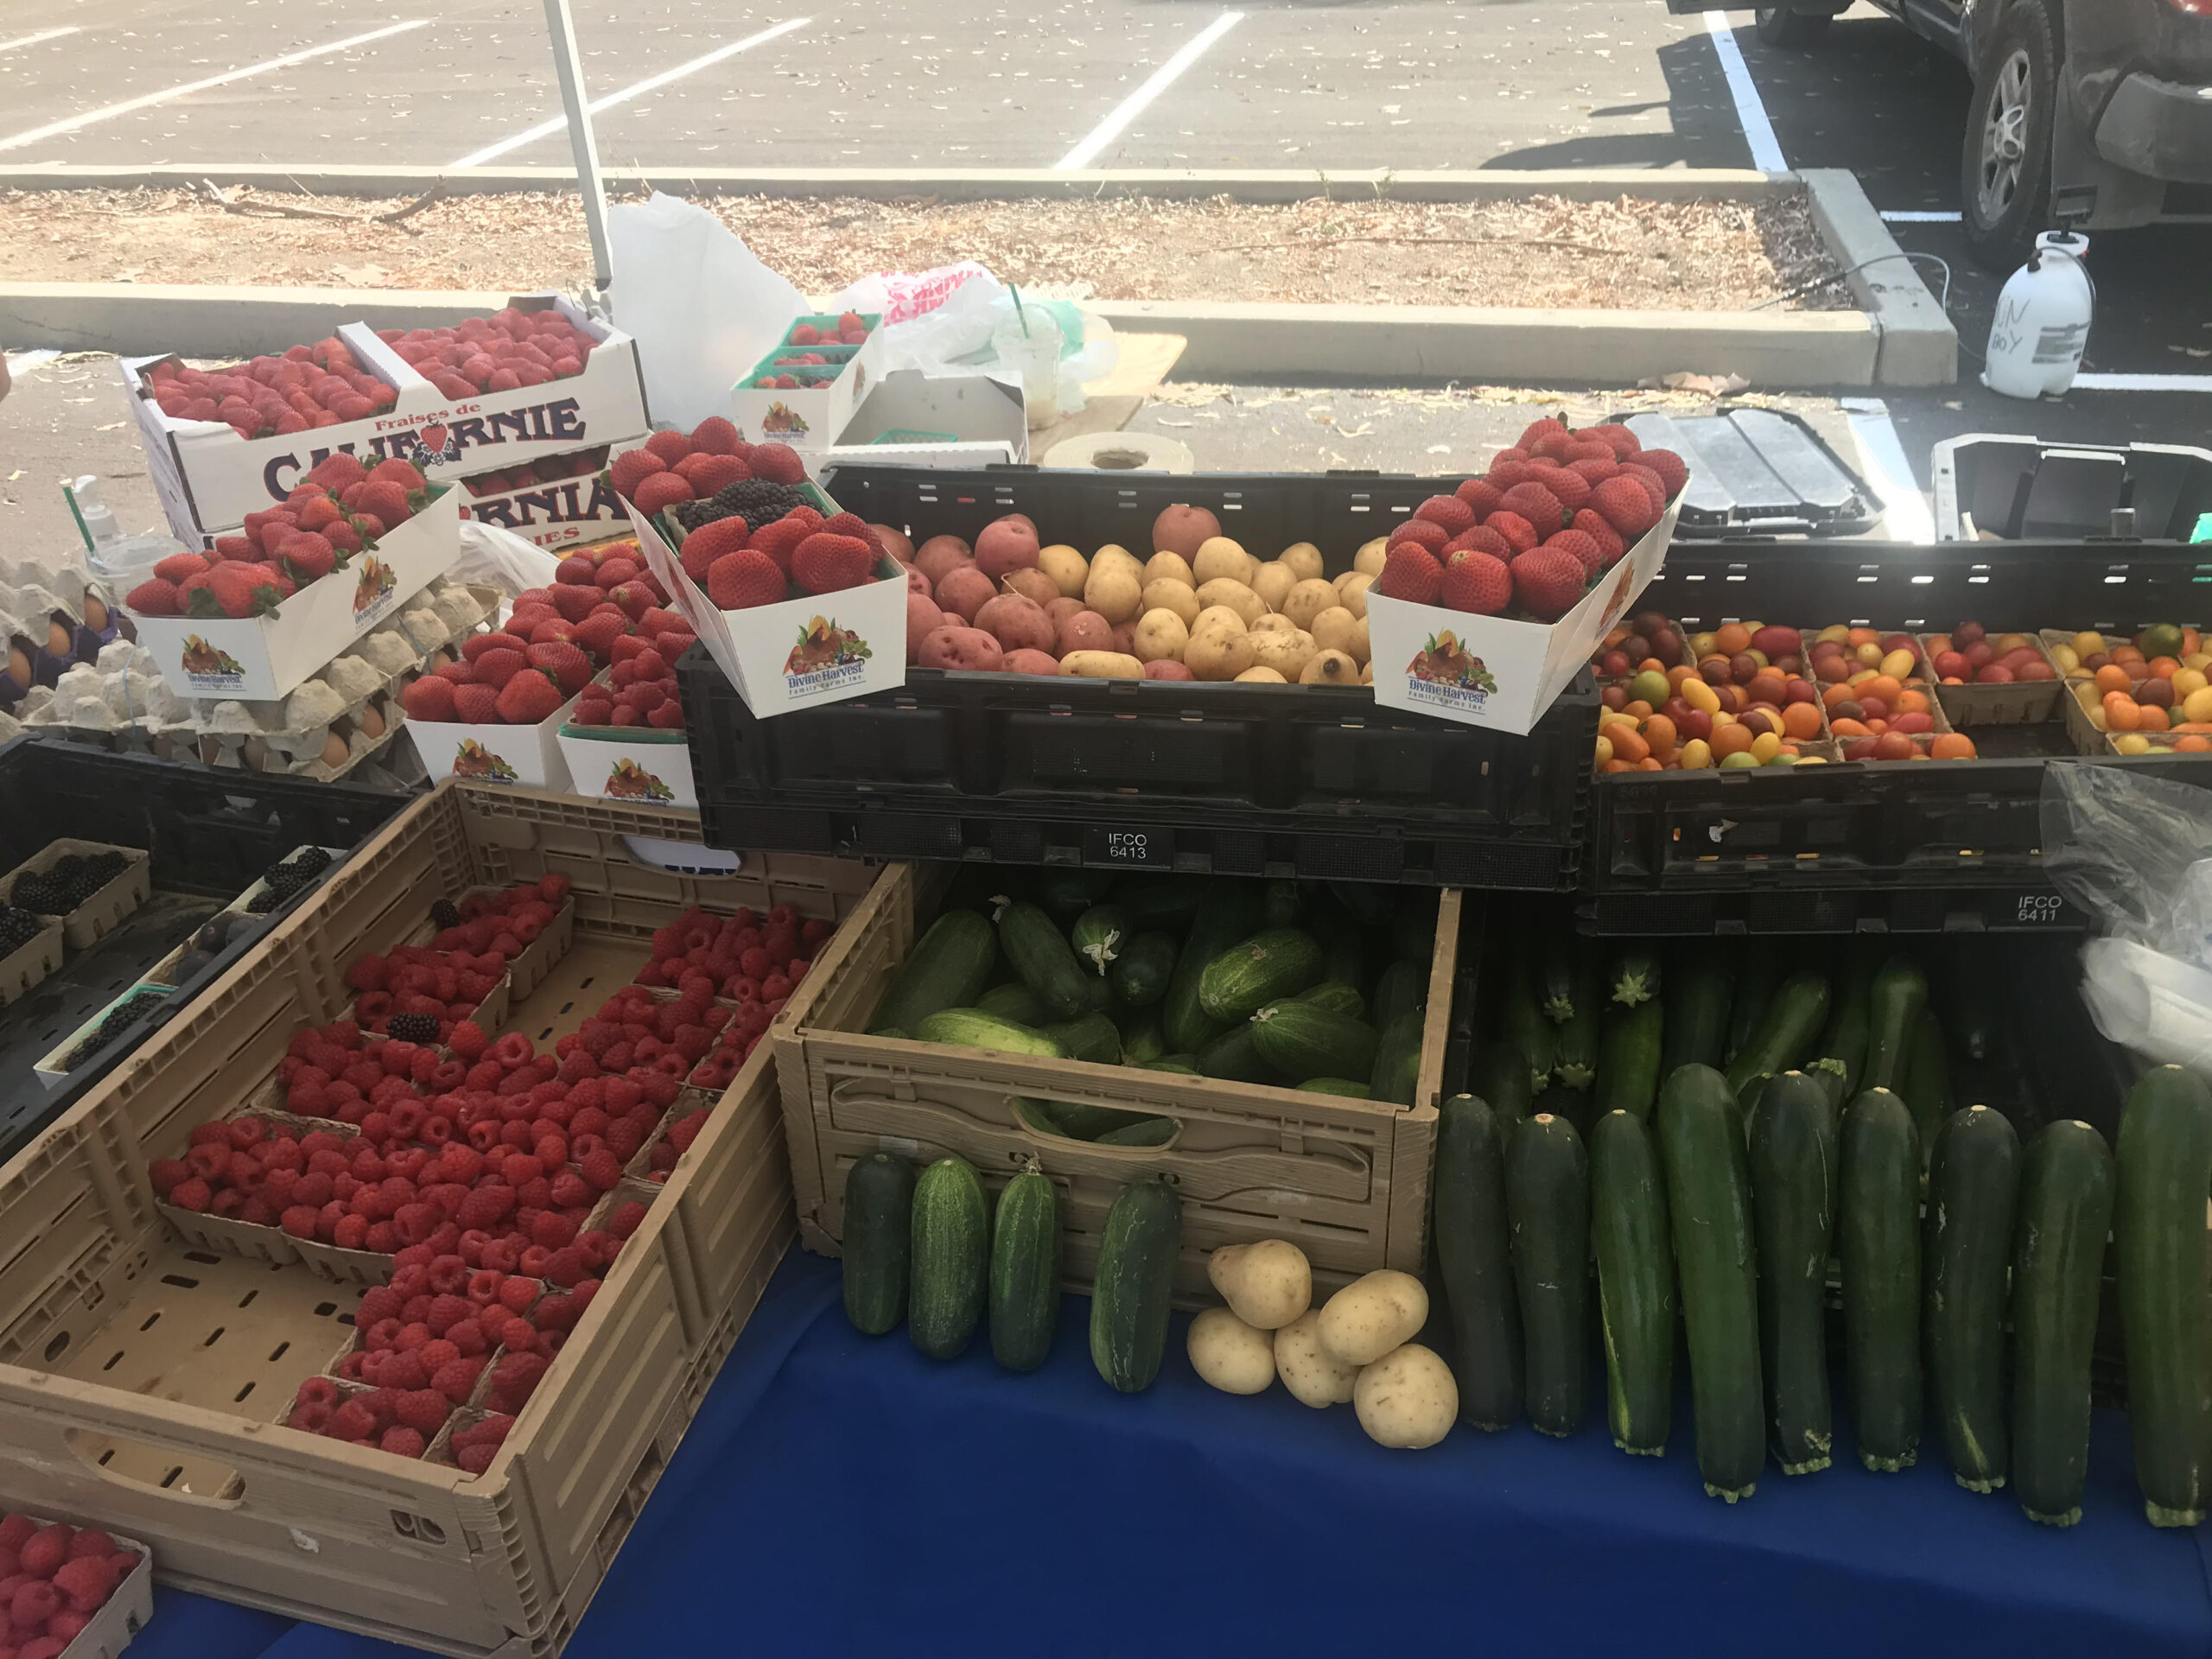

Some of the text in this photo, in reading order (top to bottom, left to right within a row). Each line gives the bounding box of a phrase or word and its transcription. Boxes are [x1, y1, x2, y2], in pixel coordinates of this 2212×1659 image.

[375, 404, 481, 431] Fraises de
[264, 397, 587, 502] CIFRNIE
[788, 663, 864, 689] Divine Harvest
[1408, 690, 1435, 702] Family
[1409, 679, 1486, 704] Divine Harvest
[1109, 832, 1147, 847] IFCO
[1109, 845, 1147, 859] 6413
[2018, 895, 2063, 909] IFCO
[2018, 908, 2056, 922] 6411
